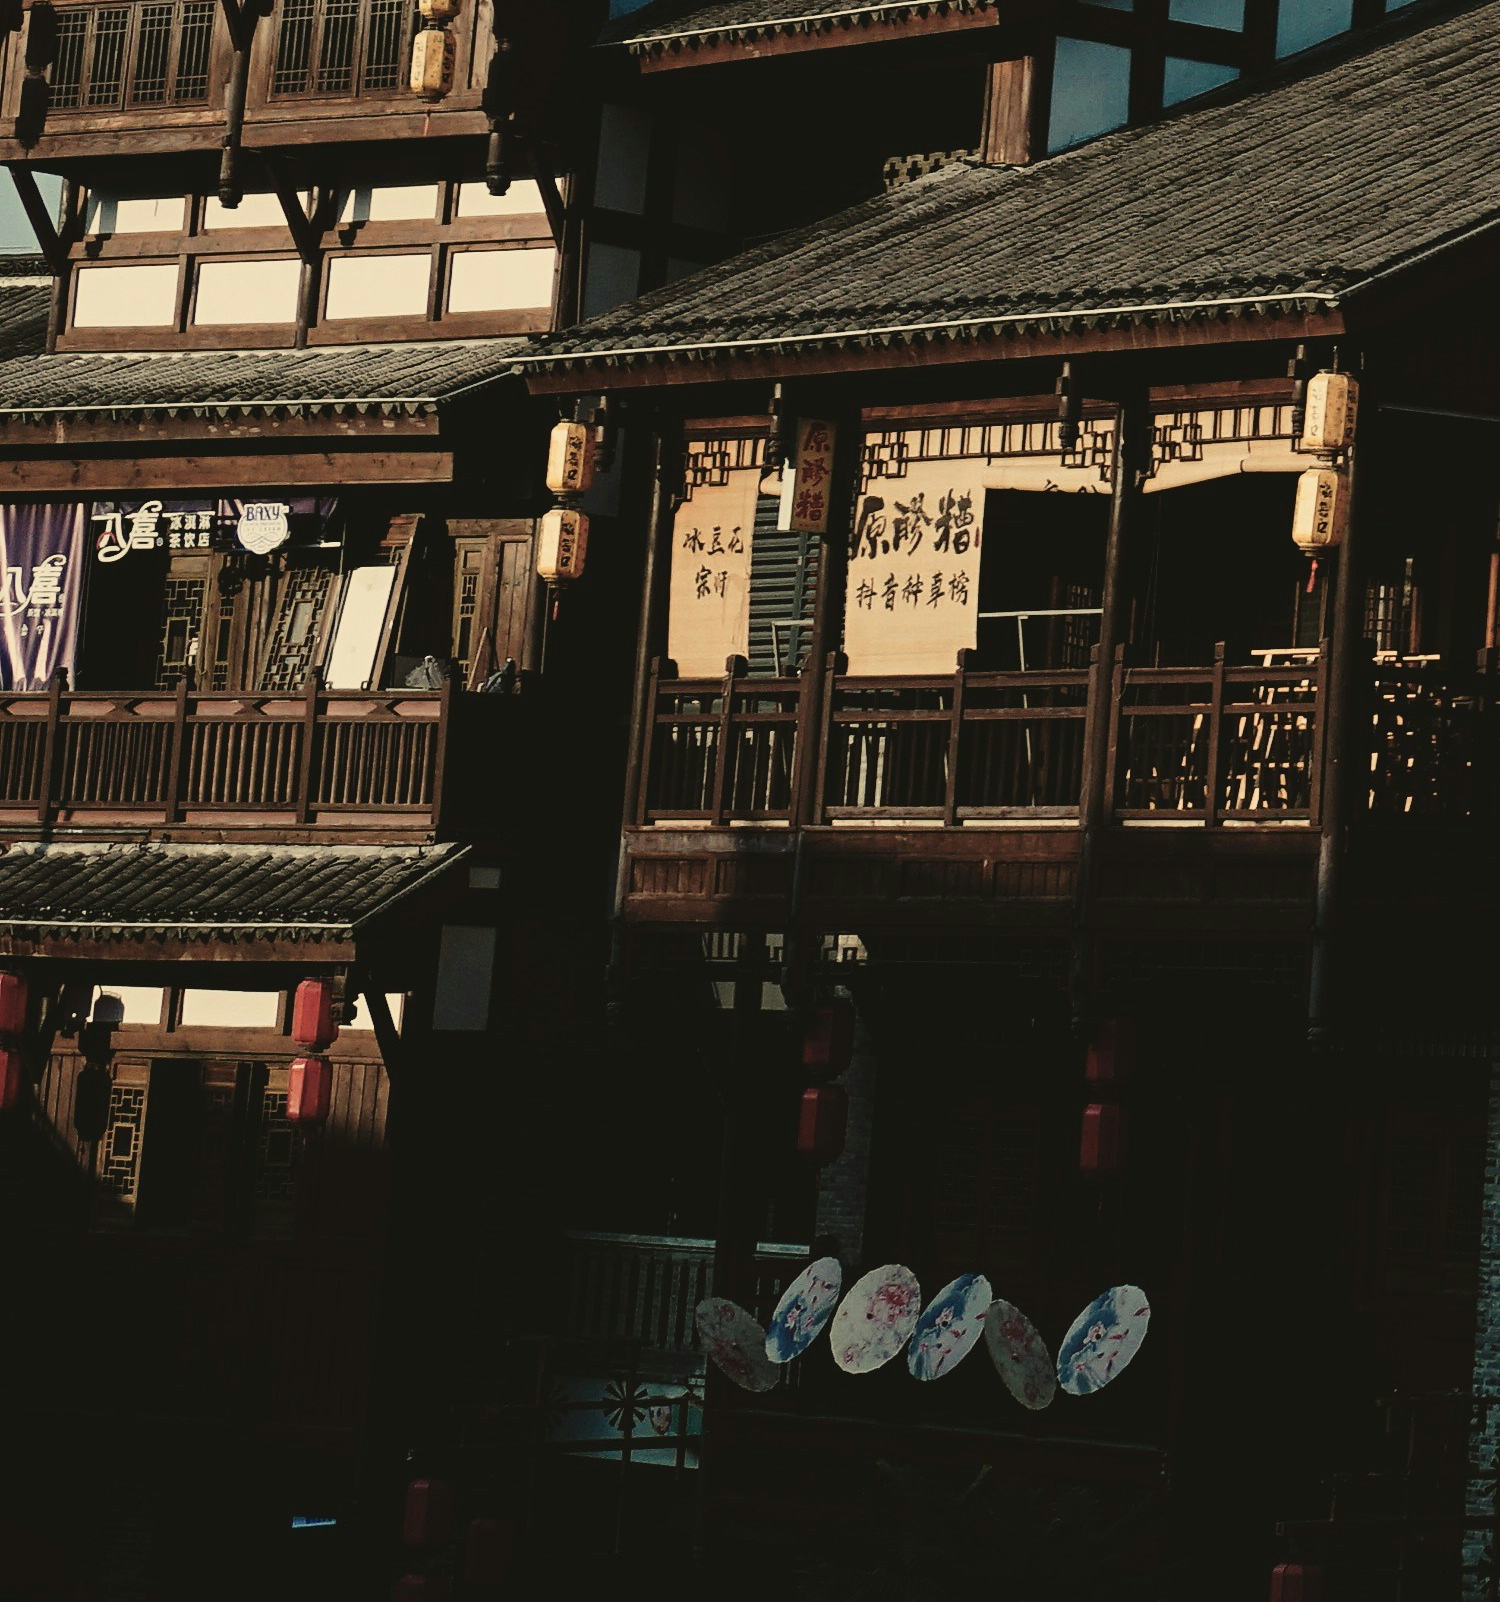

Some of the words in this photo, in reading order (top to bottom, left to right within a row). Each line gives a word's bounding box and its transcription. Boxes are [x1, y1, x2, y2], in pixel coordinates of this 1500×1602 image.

[168, 514, 212, 531] 冰淇淋
[246, 505, 281, 522] BAXY
[91, 500, 163, 563] 八喜
[848, 487, 975, 562] 原醪糟
[168, 531, 212, 549] 茶饮店
